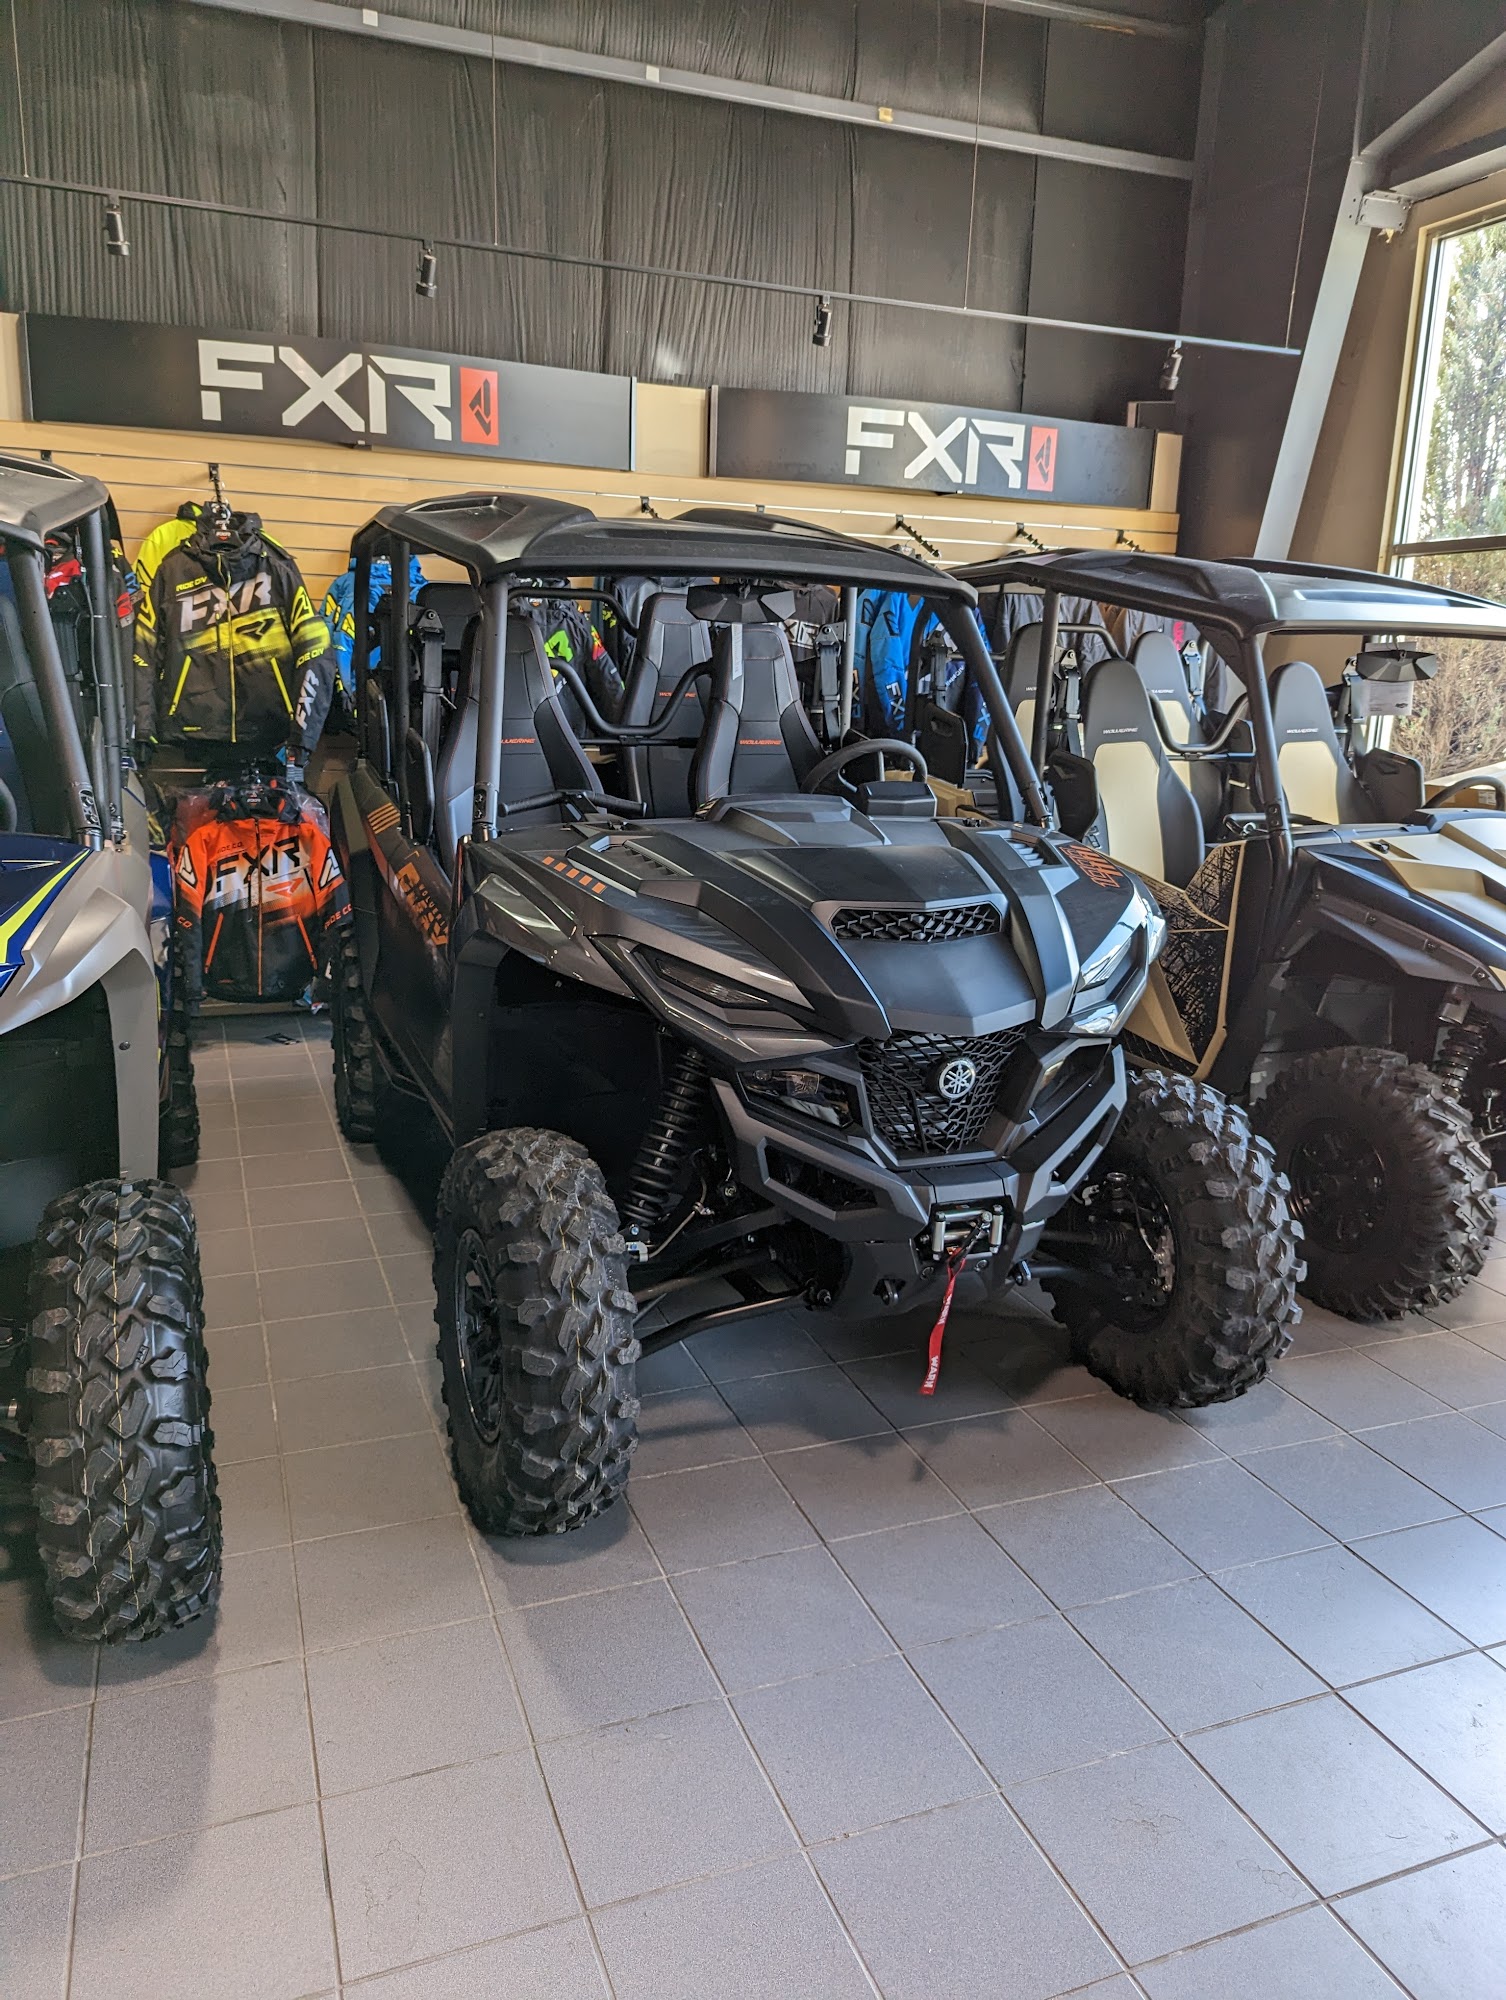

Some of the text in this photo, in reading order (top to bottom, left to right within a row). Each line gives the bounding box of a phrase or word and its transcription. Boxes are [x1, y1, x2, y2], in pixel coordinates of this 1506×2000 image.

[198, 339, 452, 441] FXR
[845, 406, 1026, 489] FXR
[176, 571, 272, 633] FXR
[296, 669, 320, 731] FXR
[216, 834, 301, 892] FXR
[923, 1355, 939, 1388] WARN
